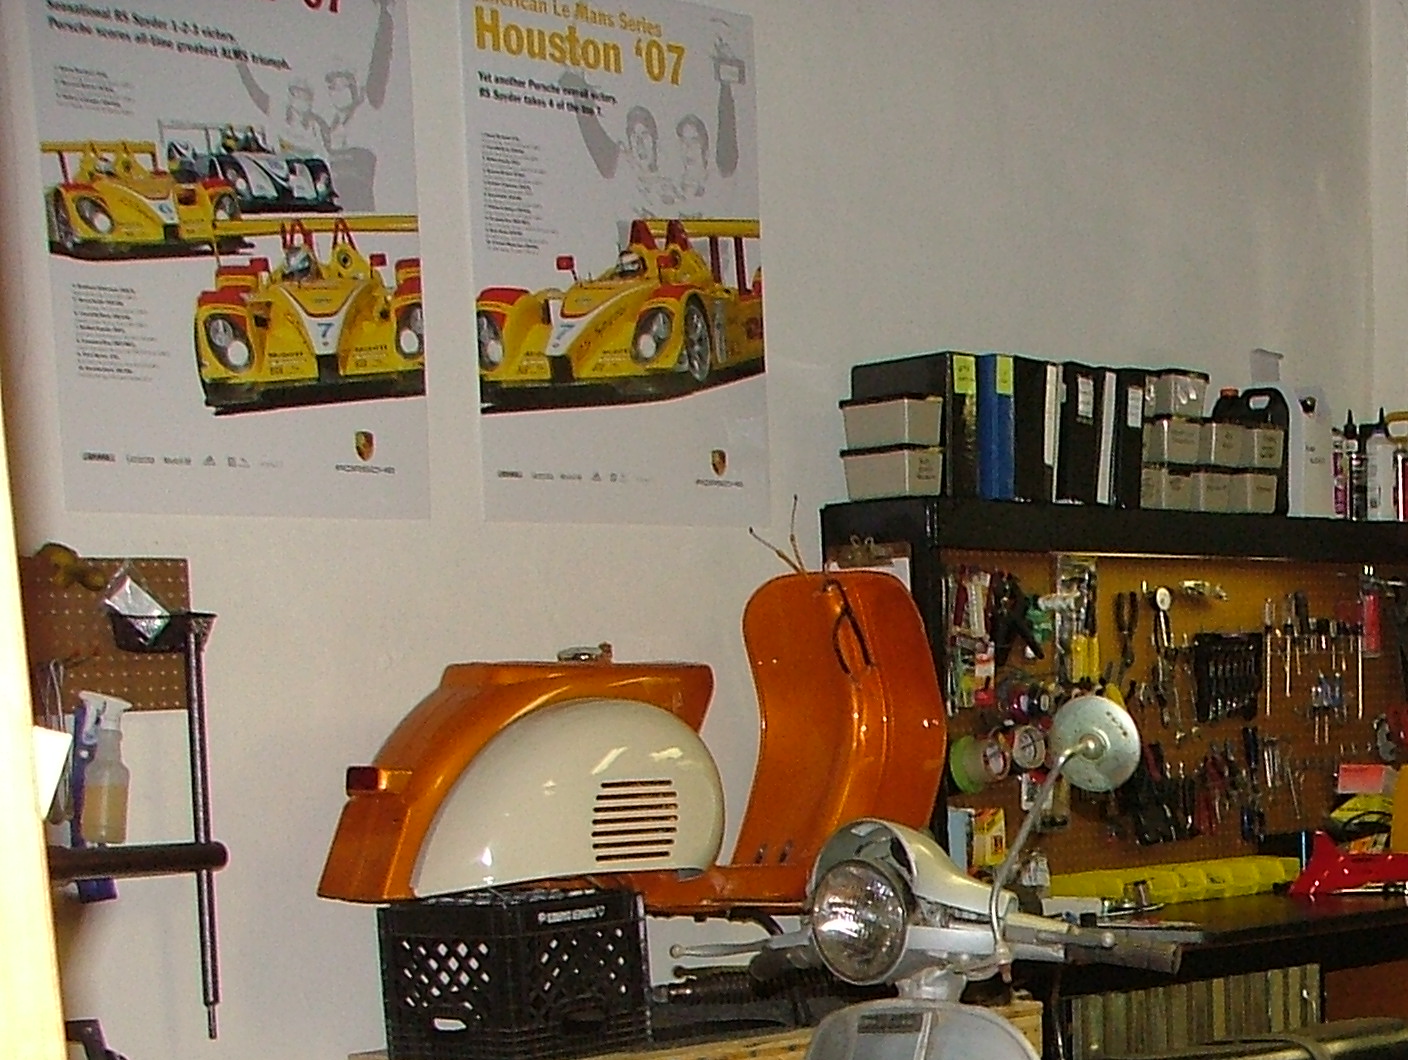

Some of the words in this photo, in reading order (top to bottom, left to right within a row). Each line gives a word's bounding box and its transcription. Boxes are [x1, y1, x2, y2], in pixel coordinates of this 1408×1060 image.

[474, 5, 622, 74] Houston
[552, 0, 571, 18] Le
[574, 2, 615, 28] Mans
[618, 11, 663, 38] Series
